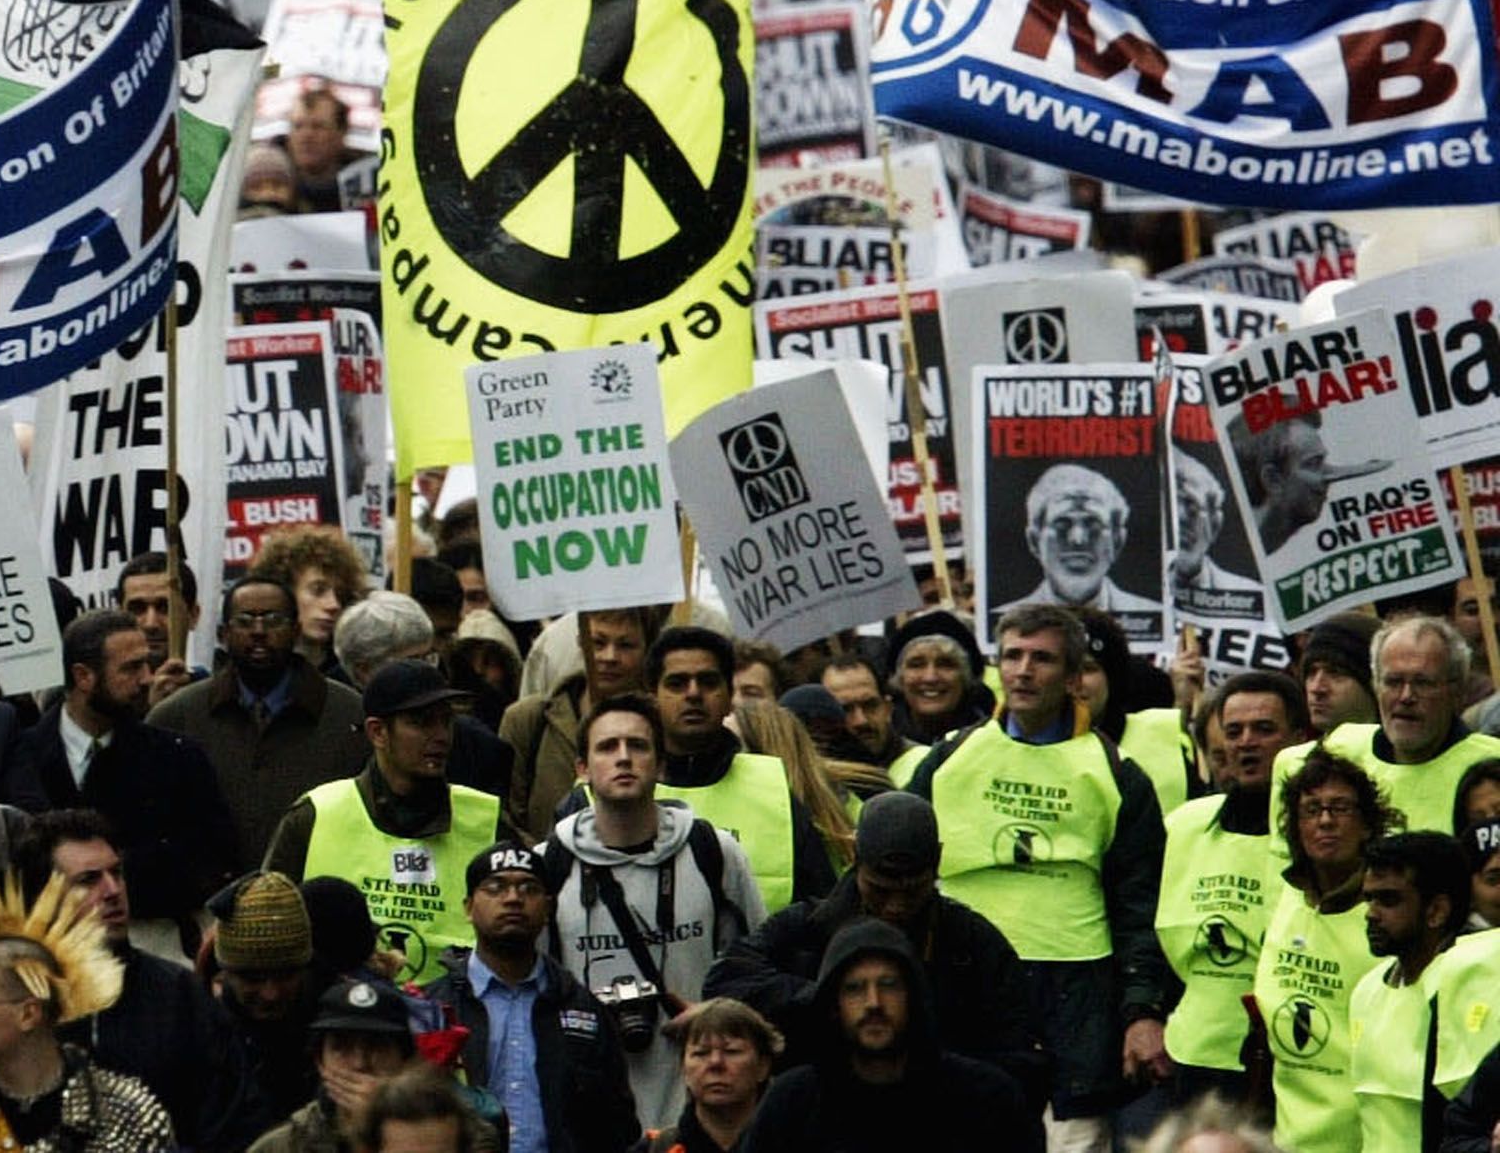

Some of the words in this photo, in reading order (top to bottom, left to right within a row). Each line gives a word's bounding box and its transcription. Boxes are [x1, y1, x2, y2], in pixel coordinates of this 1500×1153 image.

[66, 107, 106, 144] Of
[109, 3, 171, 111] Britain
[959, 65, 1493, 185] www.mabonline.net
[477, 370, 549, 396] Green
[1210, 327, 1365, 407] BLIAR!
[68, 375, 163, 460] THE
[486, 397, 547, 423] Party
[986, 379, 1114, 419] WORLD'S
[1119, 379, 1153, 416] #1
[1242, 355, 1398, 435] BLIAR!
[494, 432, 563, 468] END
[575, 422, 645, 456] THE
[988, 416, 1158, 459] TERRORIST
[296, 459, 328, 478] BAY
[742, 465, 806, 519] CND
[244, 498, 319, 527] BUSH
[491, 462, 663, 531] OCCUPATION
[1329, 479, 1432, 523] IRAQ'S
[53, 468, 190, 579] WAR
[719, 537, 763, 590] NO
[766, 500, 869, 561] MORE
[1316, 521, 1361, 552] ON
[1367, 501, 1440, 539] FIRE
[512, 523, 649, 580] NOW
[1301, 537, 1424, 611] RESPECT
[733, 564, 808, 629] WAR
[808, 542, 885, 592] LIES
[991, 778, 1068, 800] STEWARD
[393, 852, 430, 874] Bliar
[392, 895, 418, 911] THE
[1278, 950, 1341, 975] STEWARD
